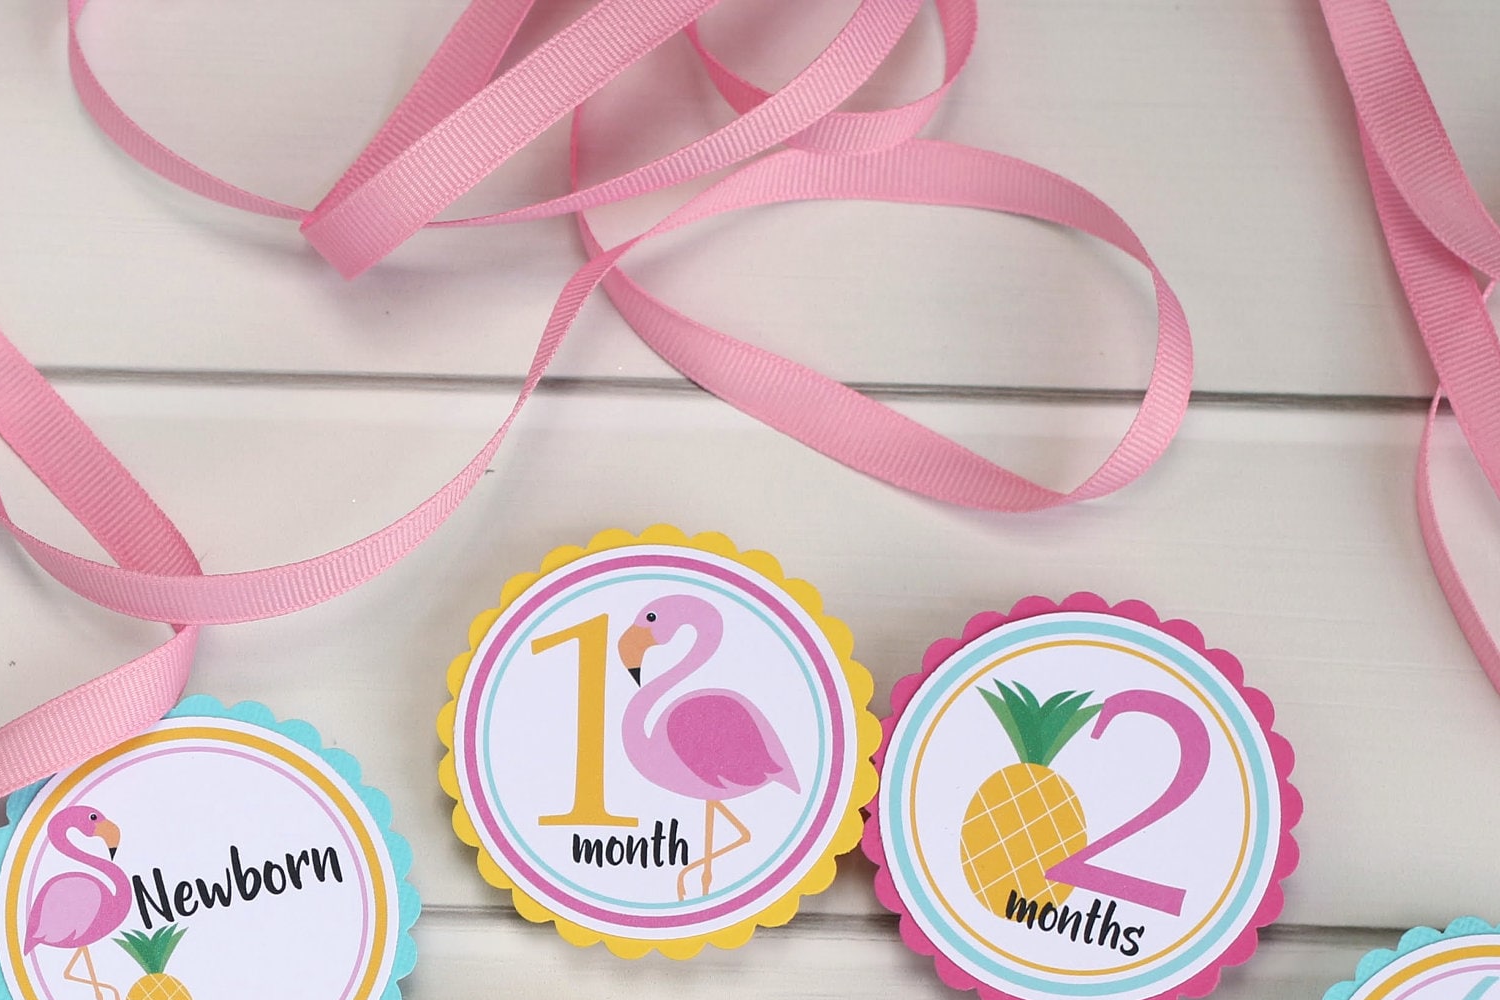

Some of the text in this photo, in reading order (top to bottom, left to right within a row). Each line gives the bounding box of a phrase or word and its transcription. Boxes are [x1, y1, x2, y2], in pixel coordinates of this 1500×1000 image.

[530, 612, 639, 828] 1
[571, 818, 690, 869] month
[1044, 688, 1211, 918] 2
[131, 845, 343, 930] Newborn
[1004, 889, 1145, 958] months
